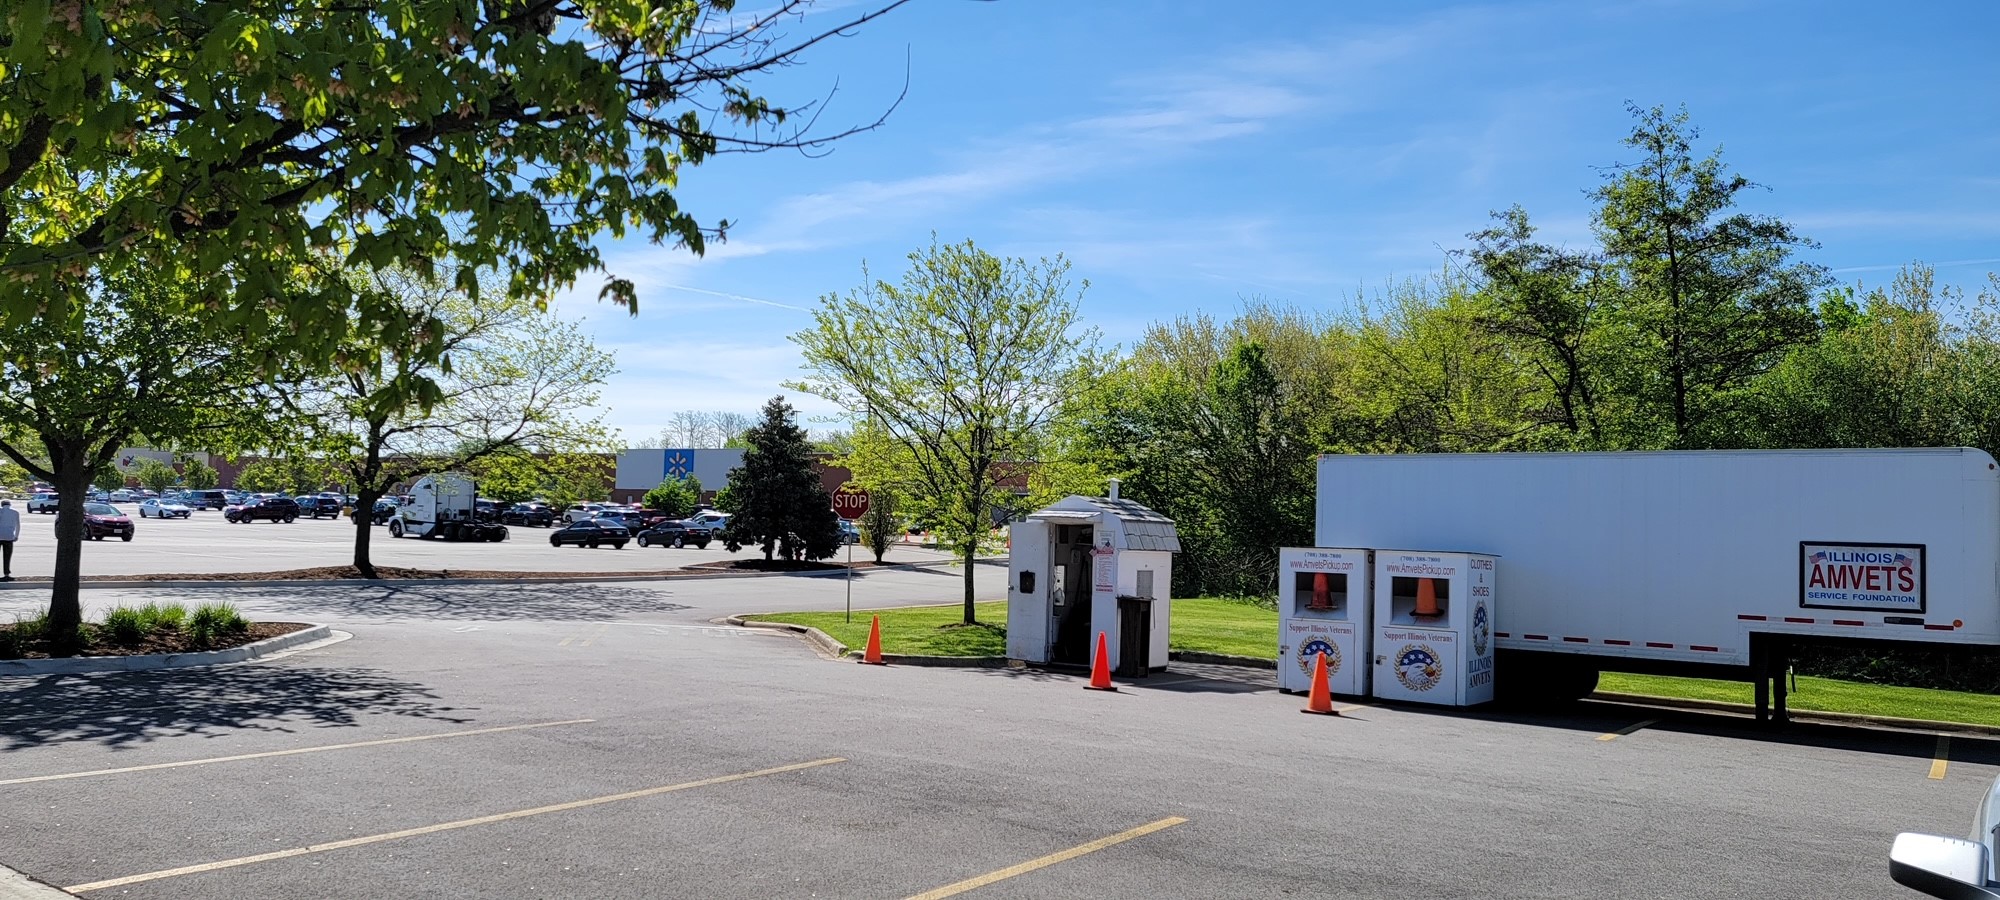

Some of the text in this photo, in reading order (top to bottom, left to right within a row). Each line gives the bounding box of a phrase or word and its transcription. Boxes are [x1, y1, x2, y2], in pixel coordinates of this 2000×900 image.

[835, 494, 867, 508] STOP
[1829, 551, 1892, 563] ILLINOIS
[1290, 559, 1354, 571] www.AmvetsPickup.com
[1387, 563, 1456, 576] www.AmvetsPickup.com
[1471, 559, 1493, 570] CLOTHES
[1808, 564, 1914, 592] AMVETS
[1473, 586, 1489, 597] SHOES
[1808, 591, 1915, 603] SERVICE FOUNDATION
[1289, 623, 1352, 634] Support Illinois Veterans
[1384, 631, 1453, 642] Support Illinois Veterans
[1468, 656, 1492, 674] ILLINOIS
[1469, 670, 1491, 688] AMVETS
